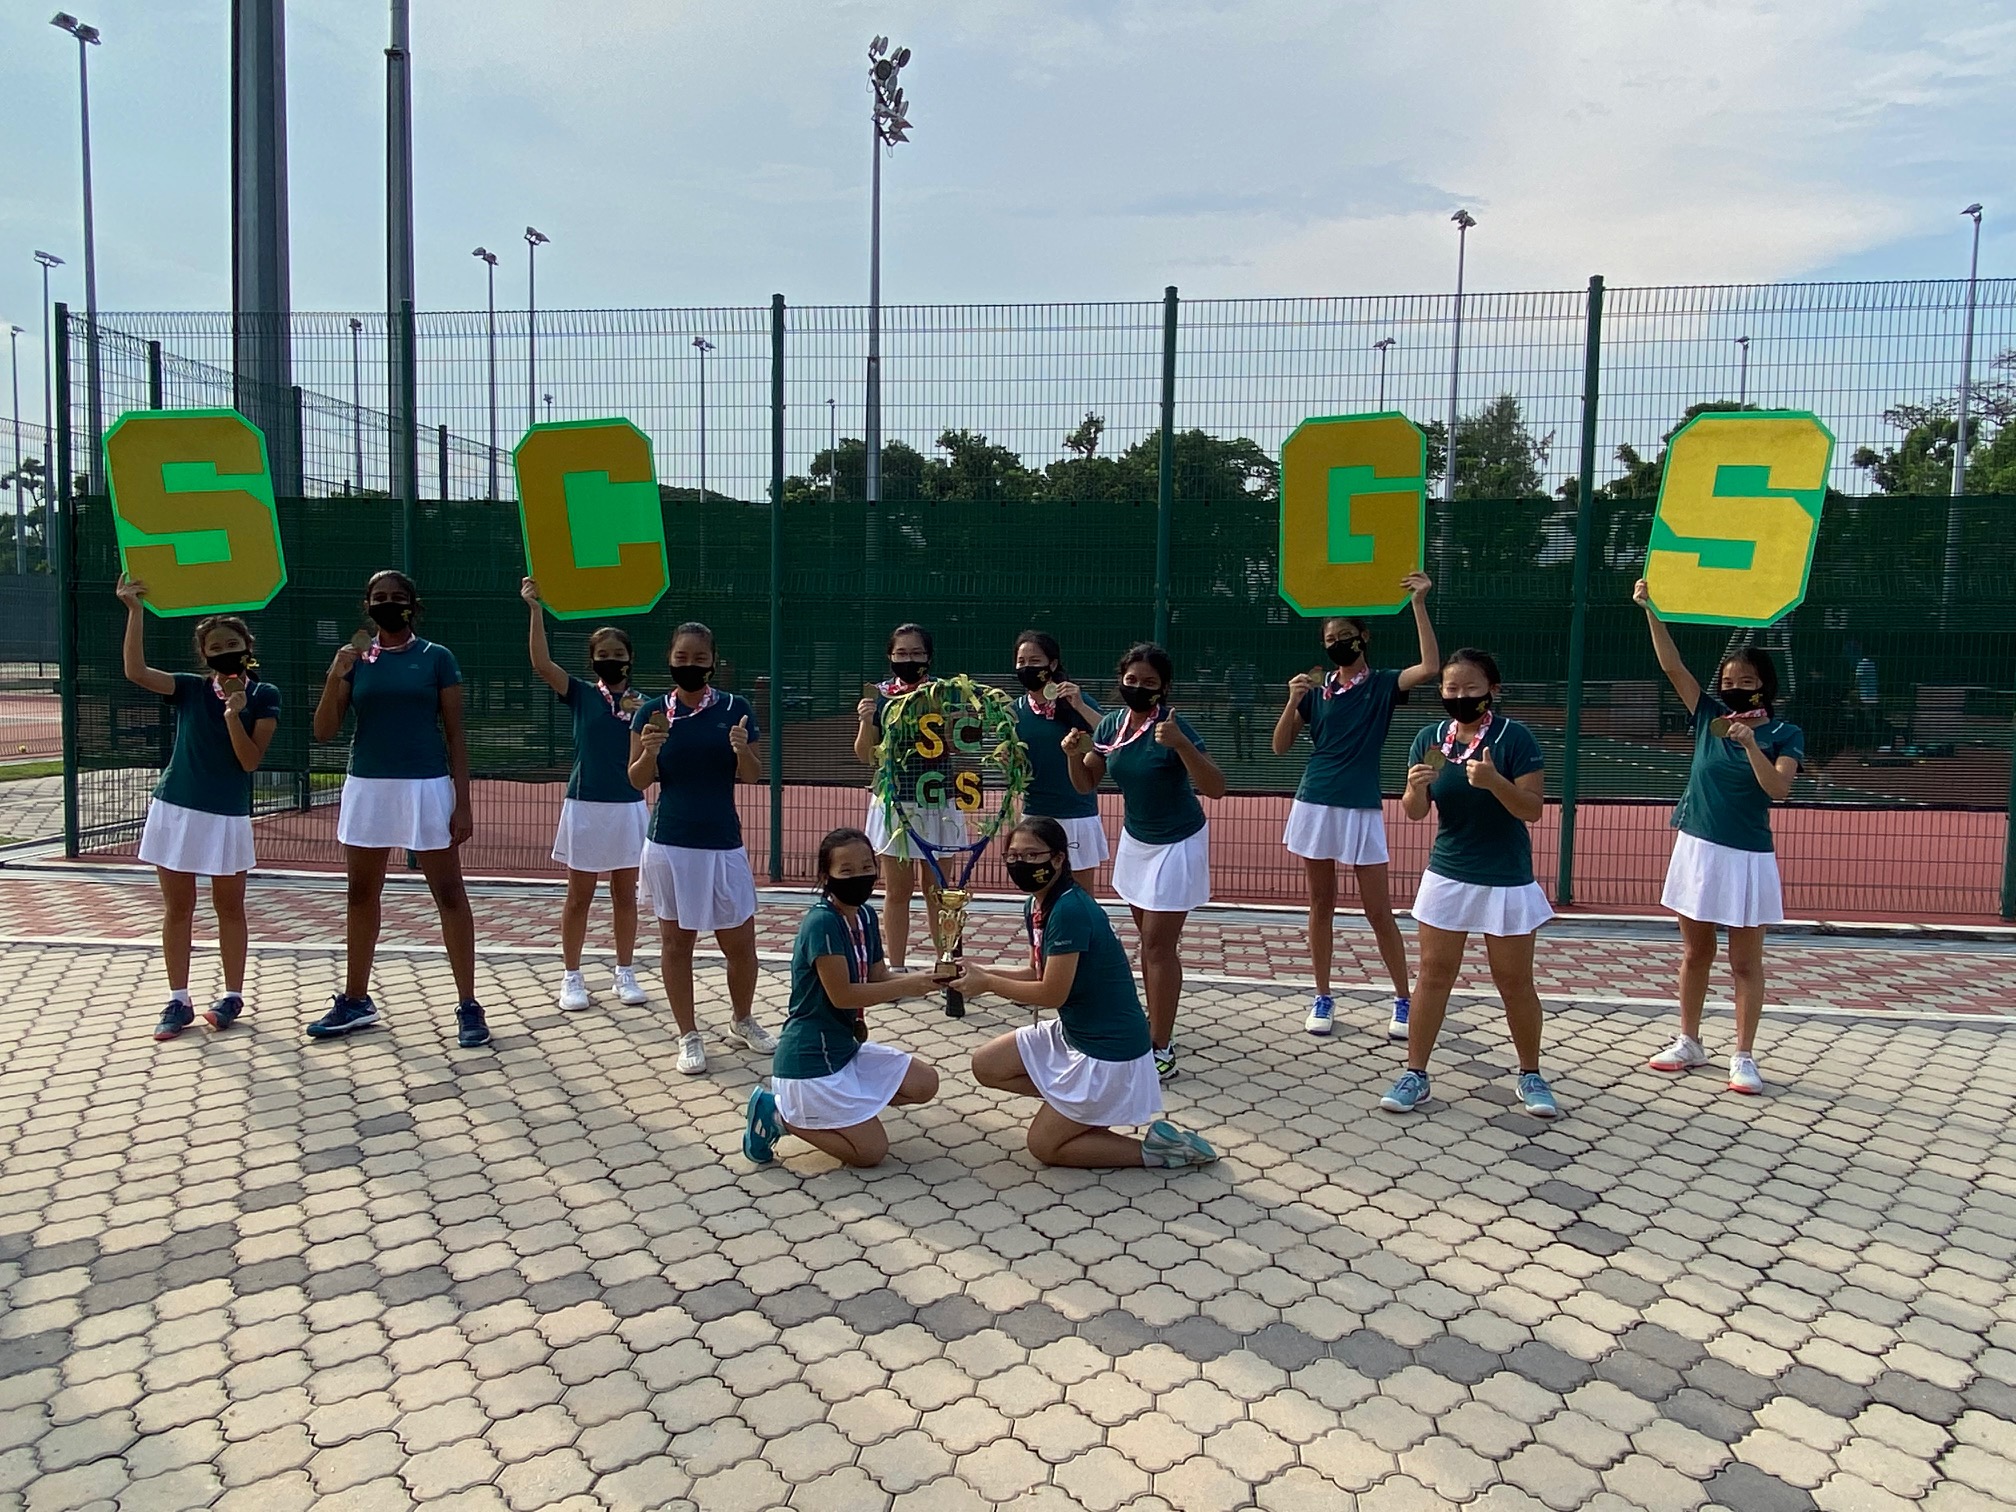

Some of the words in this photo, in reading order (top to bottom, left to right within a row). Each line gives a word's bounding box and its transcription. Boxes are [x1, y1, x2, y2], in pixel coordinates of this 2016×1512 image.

[106, 416, 283, 611] S
[515, 425, 668, 614] C
[1282, 416, 1426, 611] G
[1646, 417, 1831, 620] S
